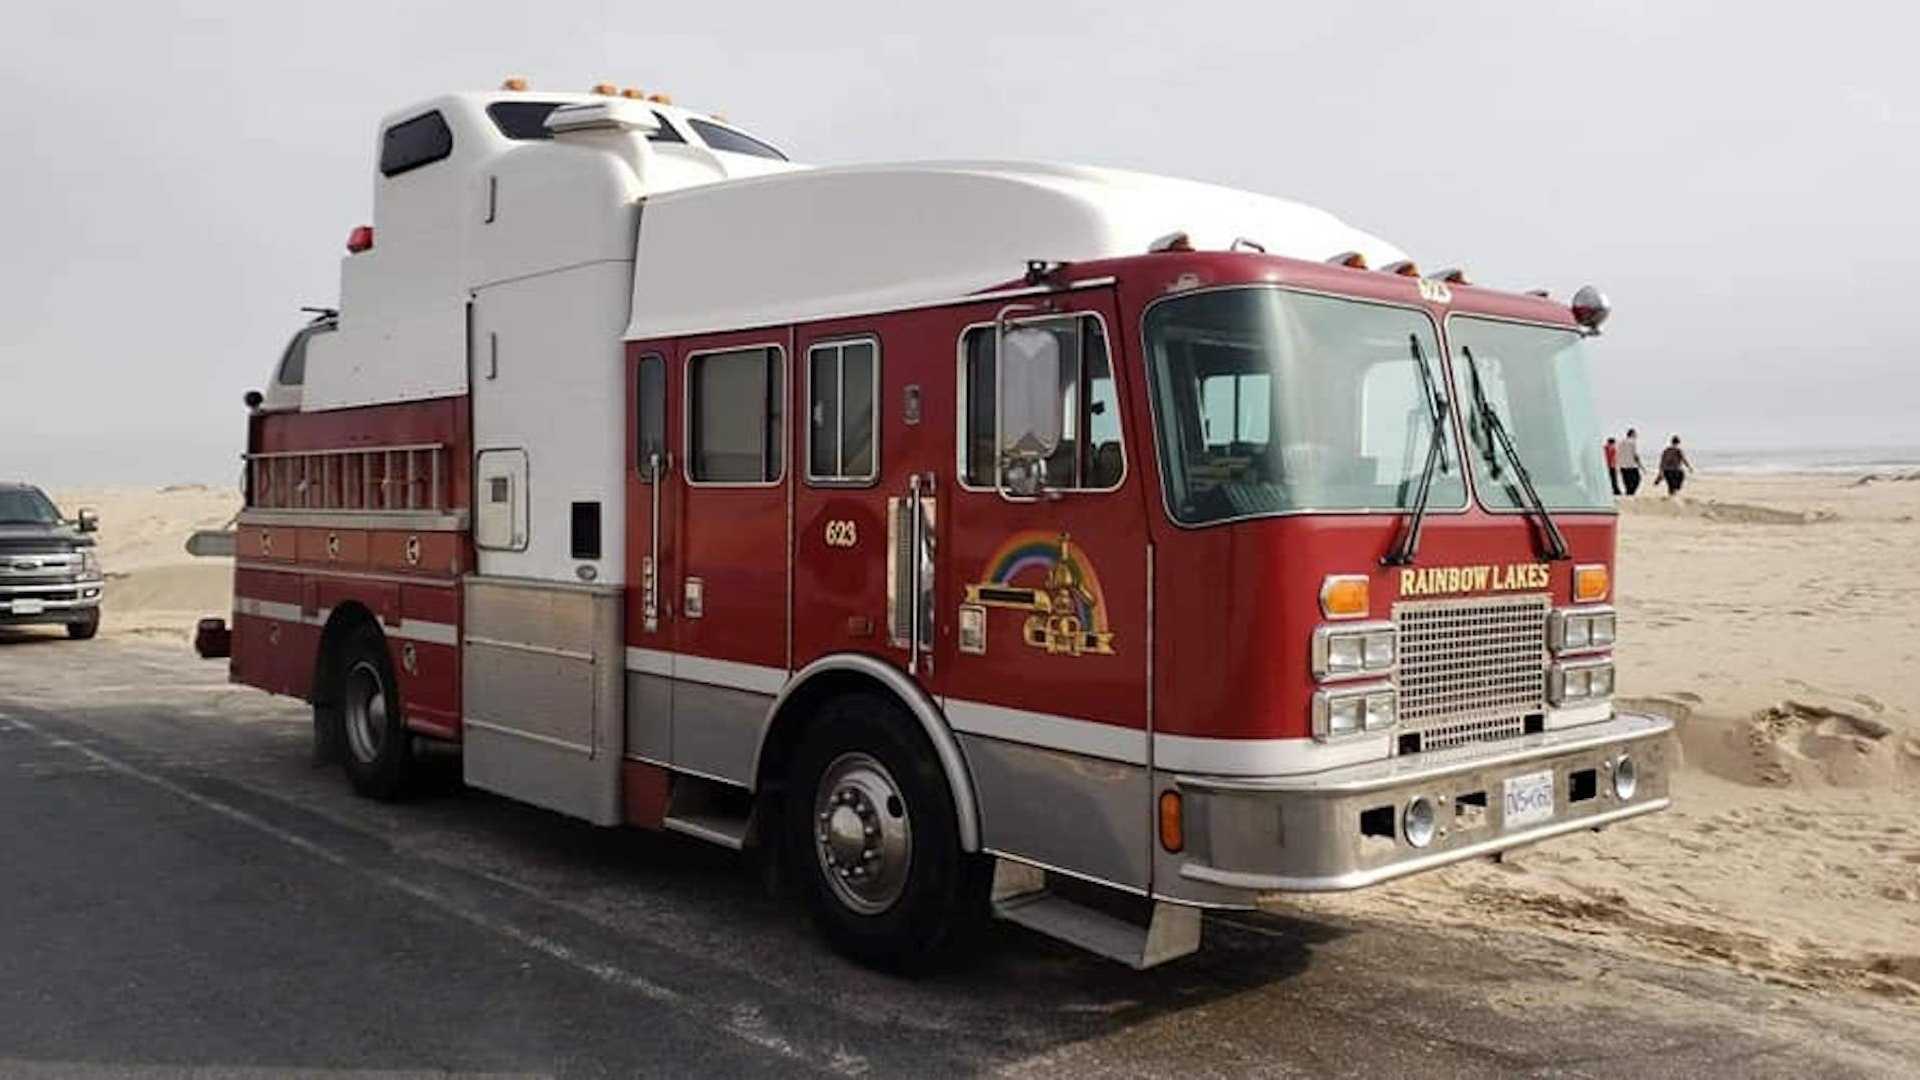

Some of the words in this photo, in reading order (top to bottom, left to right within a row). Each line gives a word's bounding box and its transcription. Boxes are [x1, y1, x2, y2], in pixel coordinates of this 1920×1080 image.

[826, 520, 856, 547] 623
[1400, 565, 1490, 596] RAINBOW
[1493, 563, 1549, 590] LAKES
